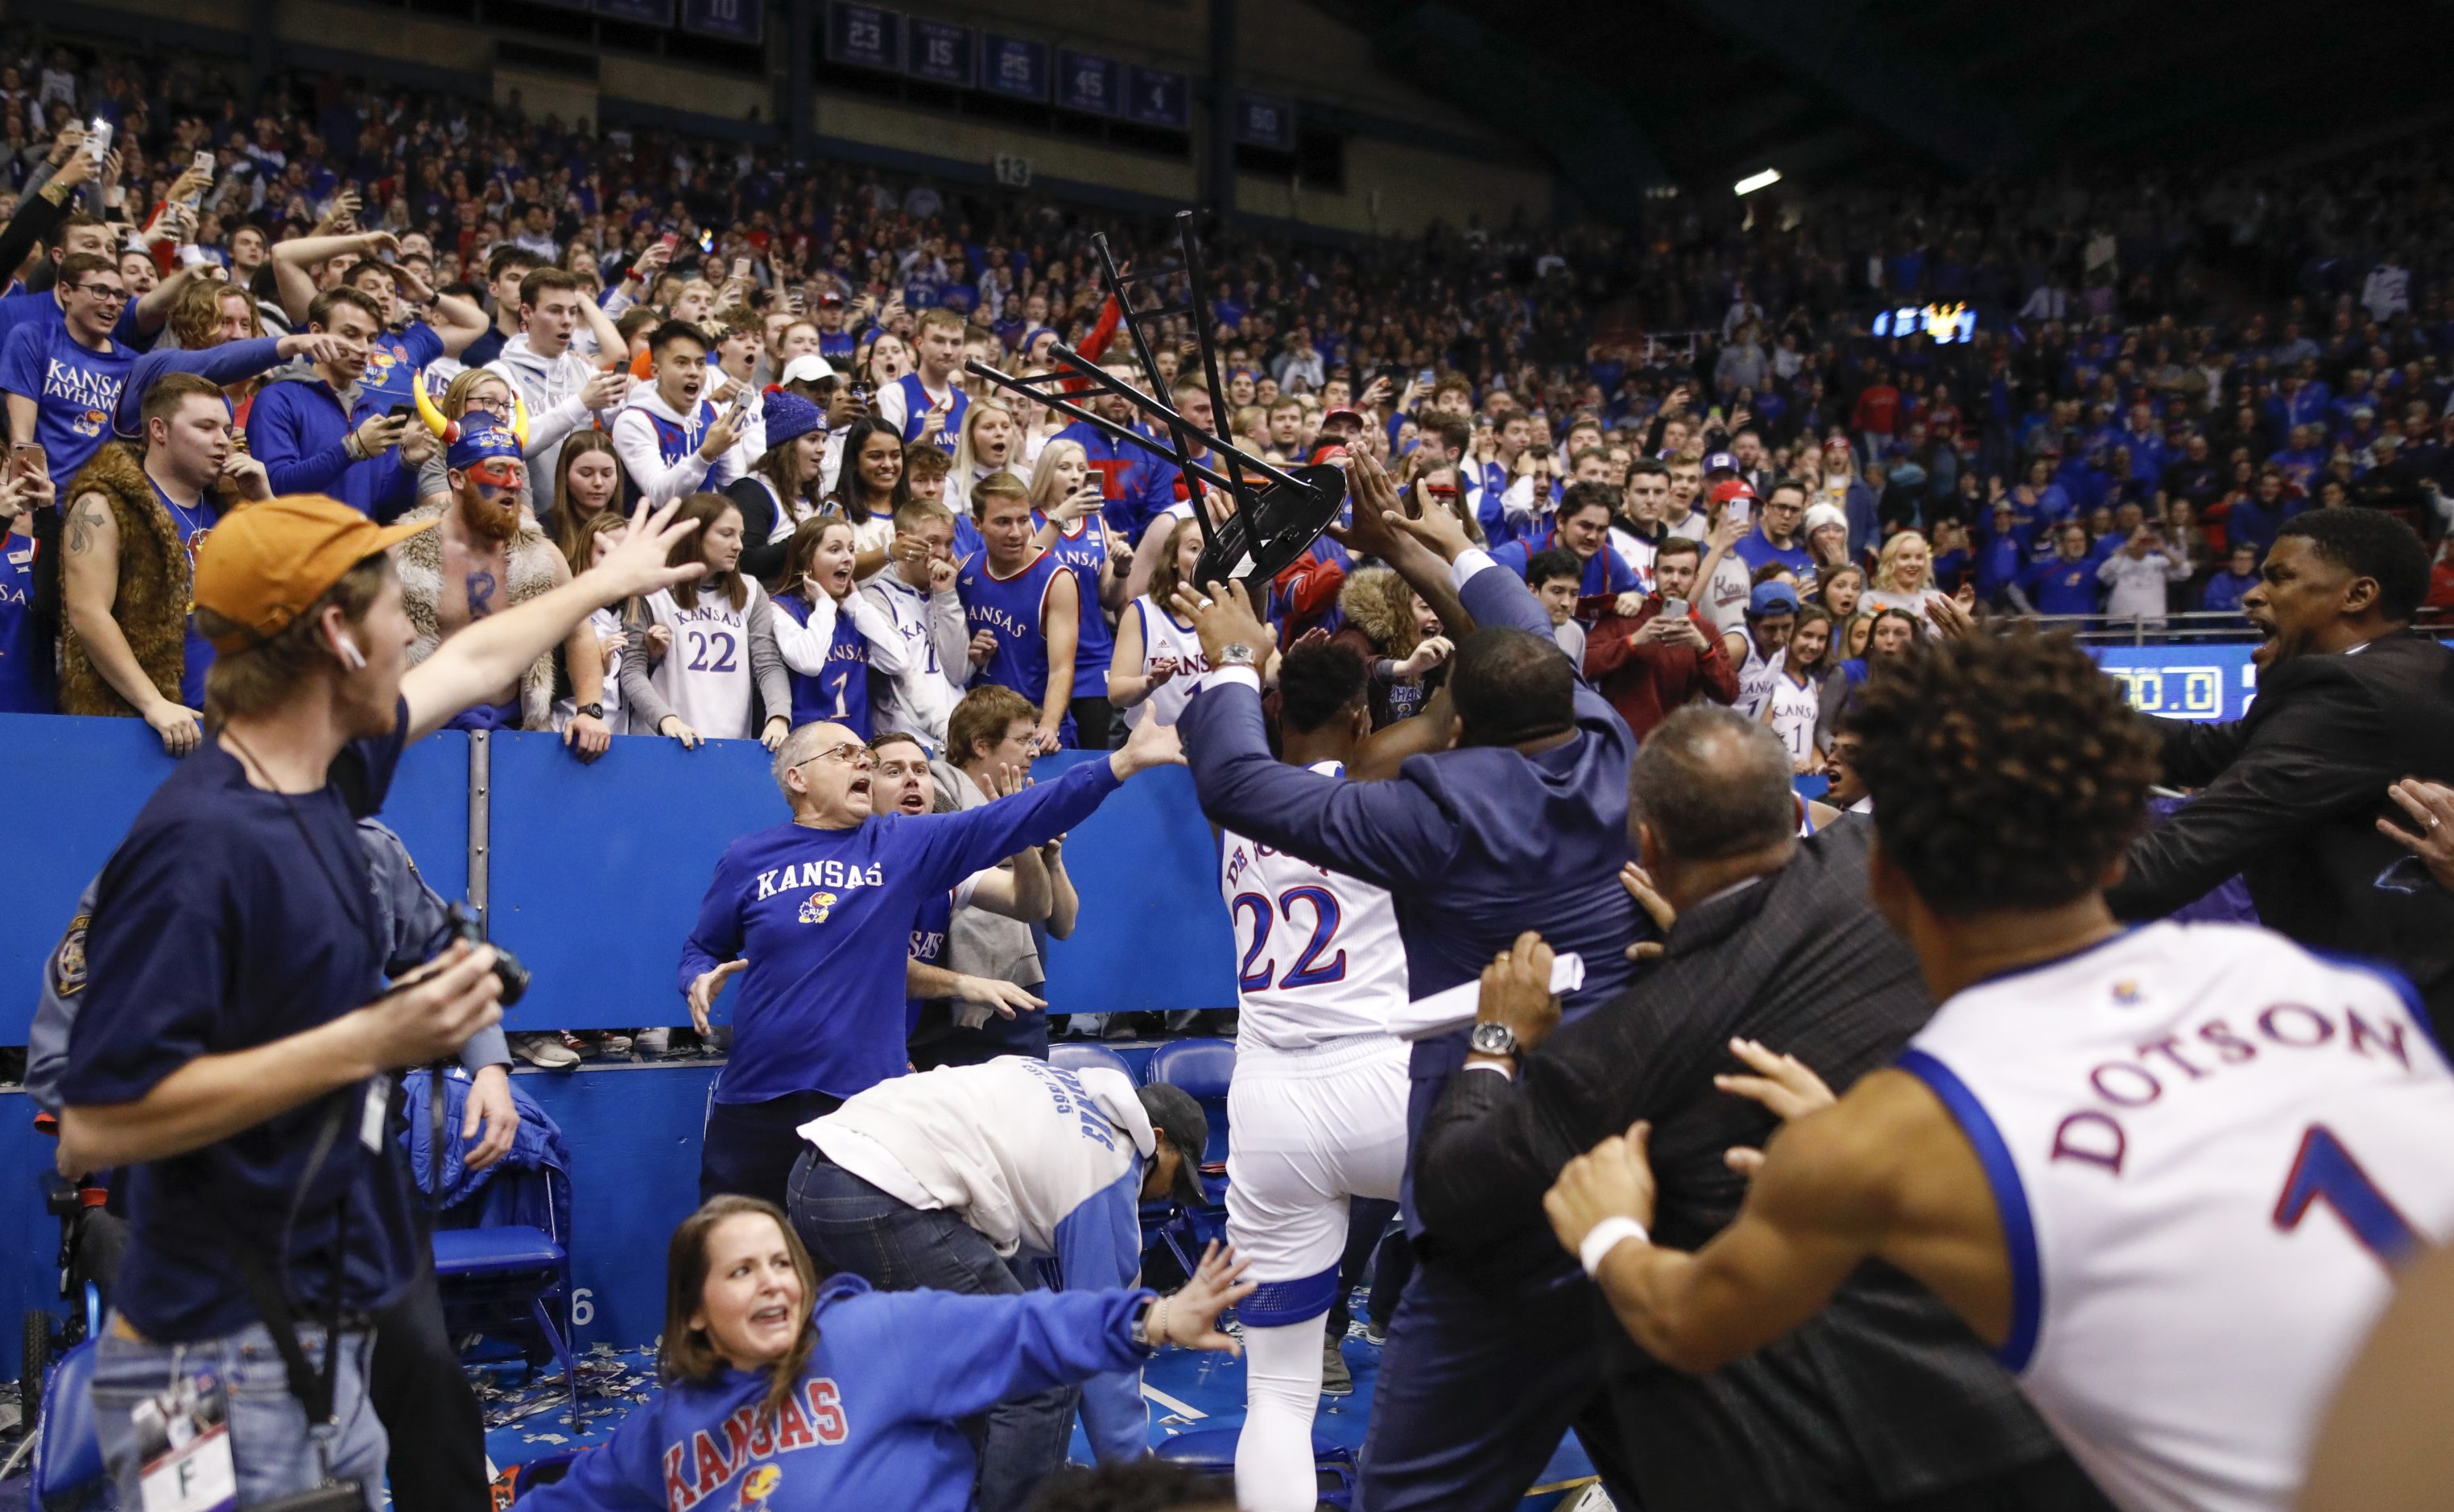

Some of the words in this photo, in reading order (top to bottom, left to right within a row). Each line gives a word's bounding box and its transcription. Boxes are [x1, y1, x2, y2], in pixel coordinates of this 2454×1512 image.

[43, 378, 118, 412] JAYHAW
[46, 357, 122, 398] KANSA
[1055, 551, 1103, 576] ANSA
[674, 607, 742, 628] KANSAS
[969, 605, 1027, 638] ANSAS
[688, 631, 737, 672] 22
[825, 643, 866, 663] ANSA
[831, 671, 851, 718] 1
[1772, 704, 1816, 720] KANSA
[1792, 723, 1802, 754] 1
[757, 860, 884, 901] KANSAS
[1227, 846, 1248, 889] DE
[908, 931, 944, 959] SAS
[1232, 886, 1345, 994] 22
[1044, 1080, 1074, 1114] 1865
[2051, 1003, 2411, 1177] DOTSON
[2272, 1122, 2422, 1272] 1
[572, 1287, 595, 1326] 6
[663, 1378, 849, 1512] KANSAS
